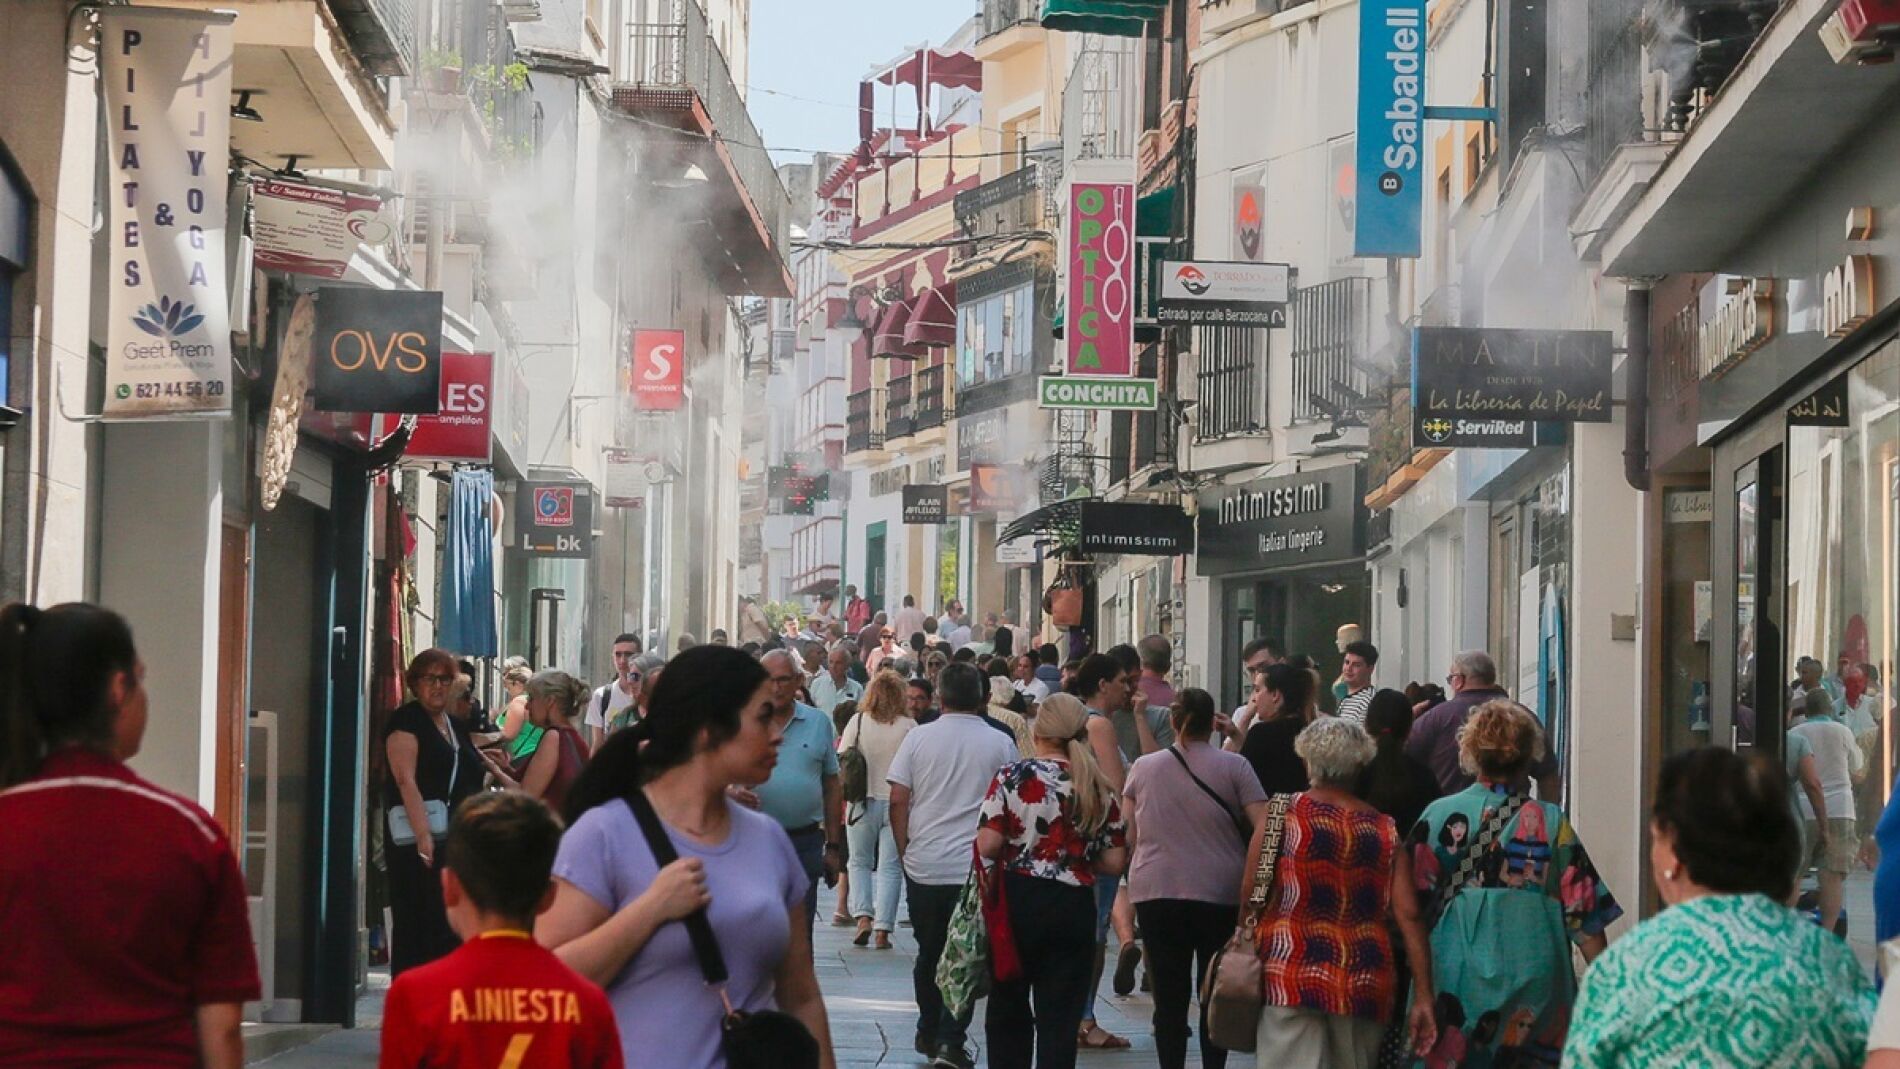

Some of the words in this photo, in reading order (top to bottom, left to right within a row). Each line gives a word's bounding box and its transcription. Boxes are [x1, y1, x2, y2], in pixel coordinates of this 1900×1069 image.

[1383, 7, 1419, 170] Sabadell
[121, 29, 142, 287] PILATES
[187, 150, 208, 287] YOGA
[1074, 187, 1105, 369] OPTICA
[1158, 306, 1189, 321] Entrada
[1190, 310, 1204, 323] por
[1205, 308, 1224, 321] calle
[1224, 308, 1269, 323] Berzocana
[123, 341, 167, 360] Geet
[169, 340, 215, 358] Prem
[330, 329, 428, 373] OVS
[1435, 334, 1598, 367] MATÍN
[165, 381, 183, 397] 44
[206, 379, 224, 396] 20
[1045, 384, 1150, 405] CONCHITA
[1429, 388, 1448, 411] La
[1529, 390, 1549, 411] de
[1554, 388, 1604, 417] Papel
[439, 415, 484, 426] amplifon
[1455, 419, 1525, 435] ServiRed
[1258, 532, 1287, 554] Italian
[450, 987, 582, 1025] A.INIESTA
